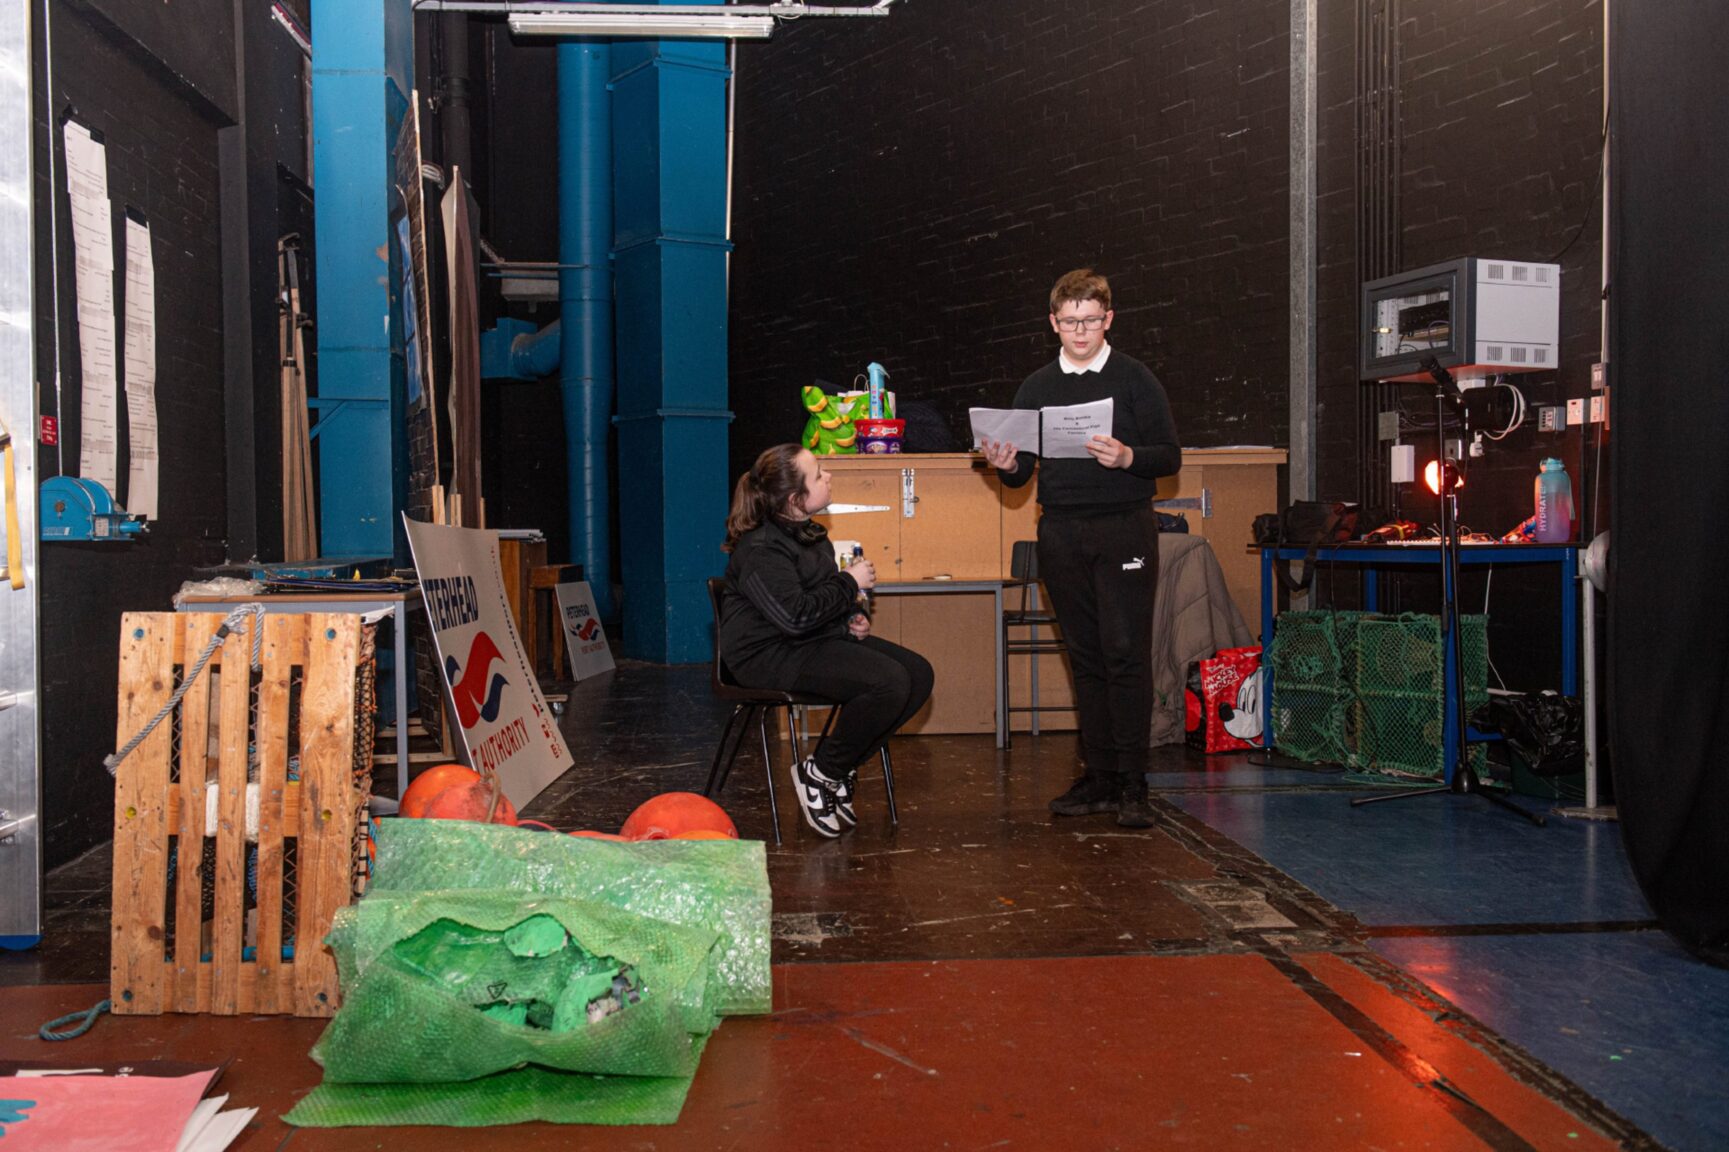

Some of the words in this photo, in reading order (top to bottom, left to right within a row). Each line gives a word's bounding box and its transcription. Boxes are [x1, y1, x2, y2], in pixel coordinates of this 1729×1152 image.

[1204, 664, 1237, 688] MICKEY
[1208, 674, 1240, 695] MOUSE
[479, 716, 530, 774] AUTHORITY
